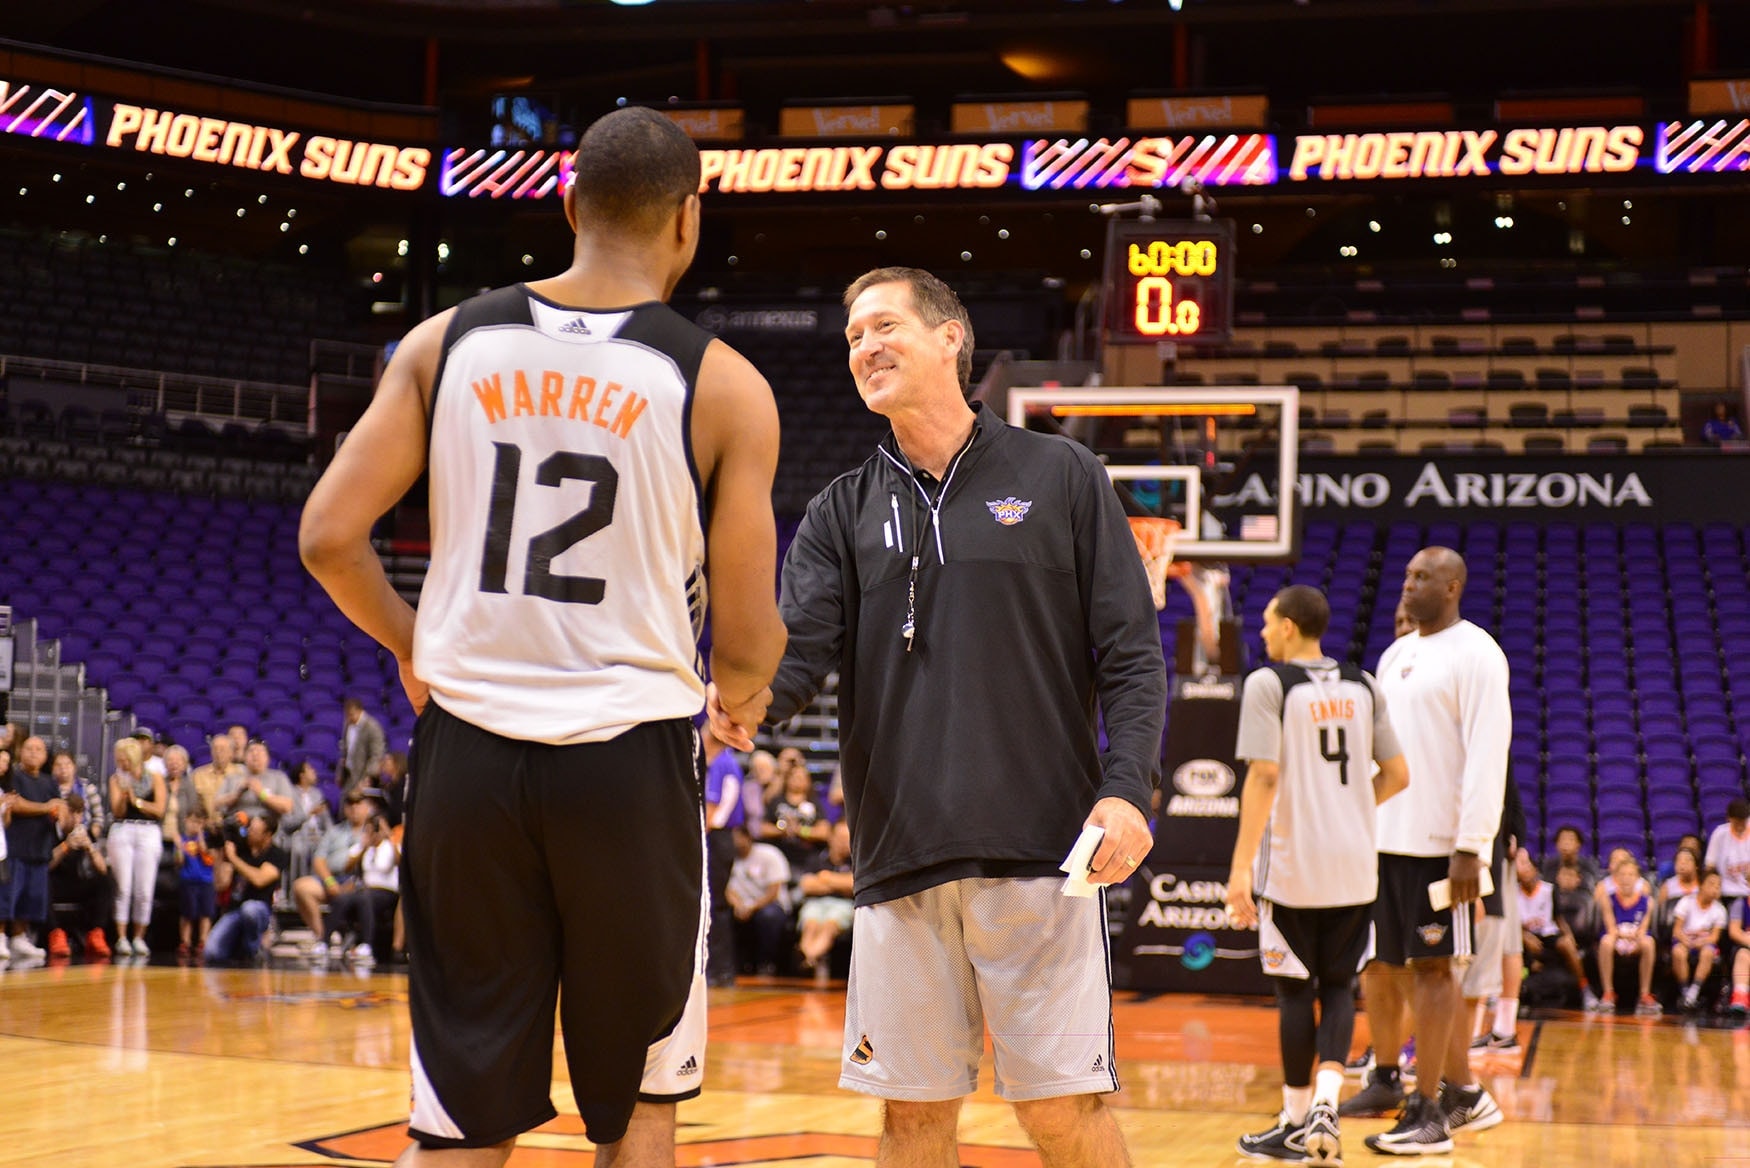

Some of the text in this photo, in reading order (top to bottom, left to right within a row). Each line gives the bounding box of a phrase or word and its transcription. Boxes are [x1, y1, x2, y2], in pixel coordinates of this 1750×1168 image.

[105, 103, 431, 190] PHOENIX SUNS
[698, 143, 1014, 193] PHOENIX SUNS
[1289, 125, 1644, 180] PHOENIX SUNS
[1128, 241, 1217, 276] 60:00
[558, 325, 592, 336] adidas
[471, 369, 648, 440] WARREN
[1404, 461, 1653, 508] ARIZONA
[478, 441, 619, 605] 12
[997, 510, 1021, 519] PHX
[1309, 698, 1355, 723] ENNIS
[1319, 727, 1349, 785] 4
